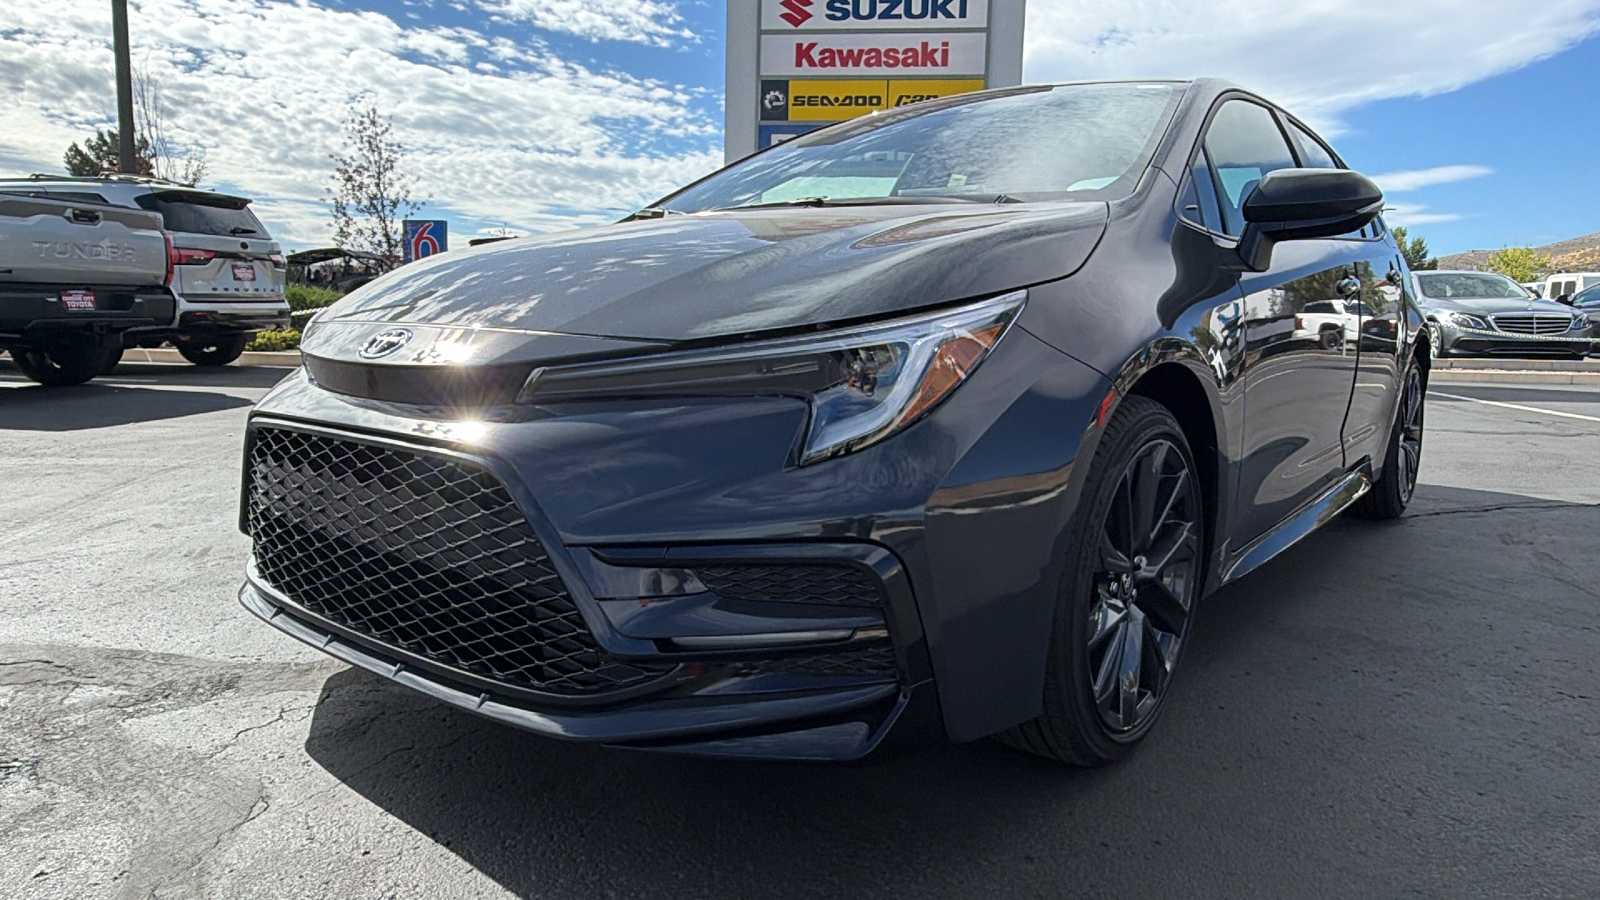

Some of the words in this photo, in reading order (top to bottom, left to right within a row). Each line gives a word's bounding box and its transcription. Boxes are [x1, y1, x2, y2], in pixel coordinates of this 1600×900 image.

[825, 0, 968, 21] SUZUKI
[795, 41, 950, 68] Kawasaki
[411, 222, 440, 261] 6
